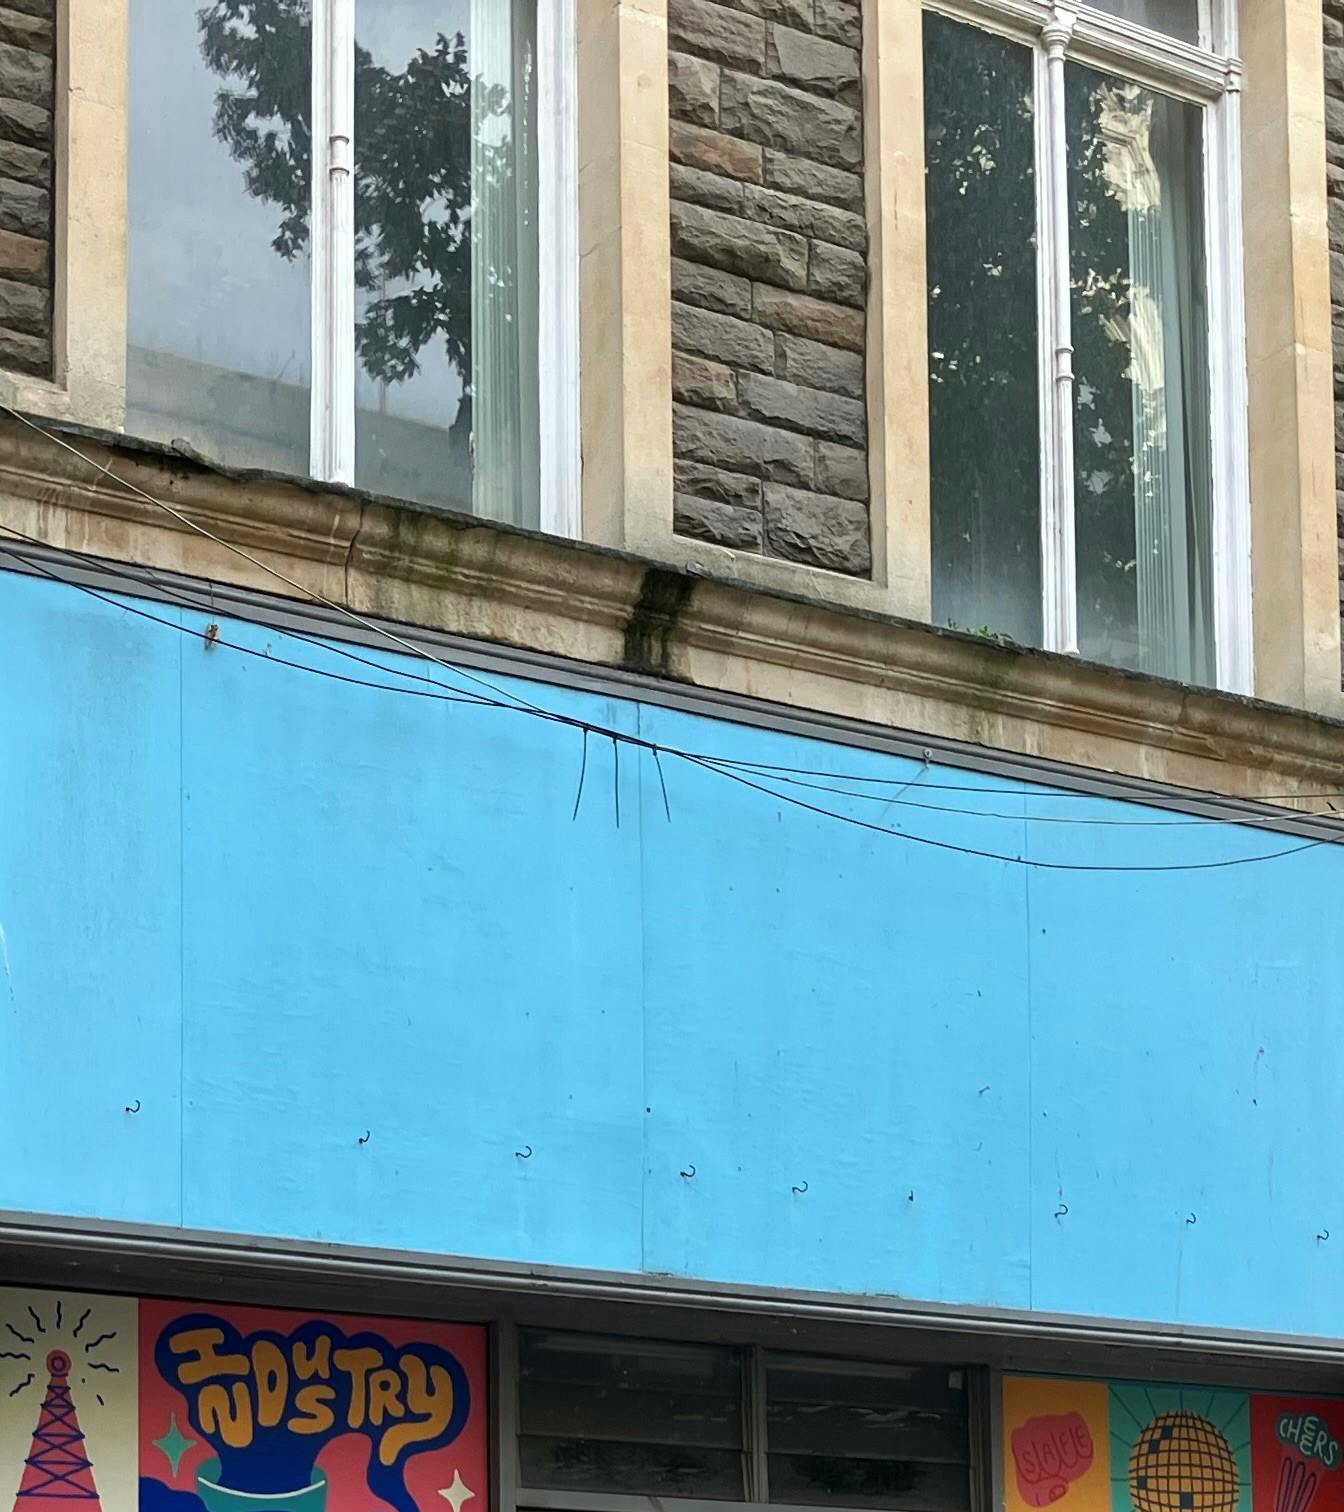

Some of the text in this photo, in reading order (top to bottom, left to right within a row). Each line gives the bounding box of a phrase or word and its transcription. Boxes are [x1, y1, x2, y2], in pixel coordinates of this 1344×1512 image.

[169, 1327, 454, 1466] INDUSTRY
[1020, 1423, 1090, 1474] SAFE
[1279, 1415, 1339, 1466] CHEERS
